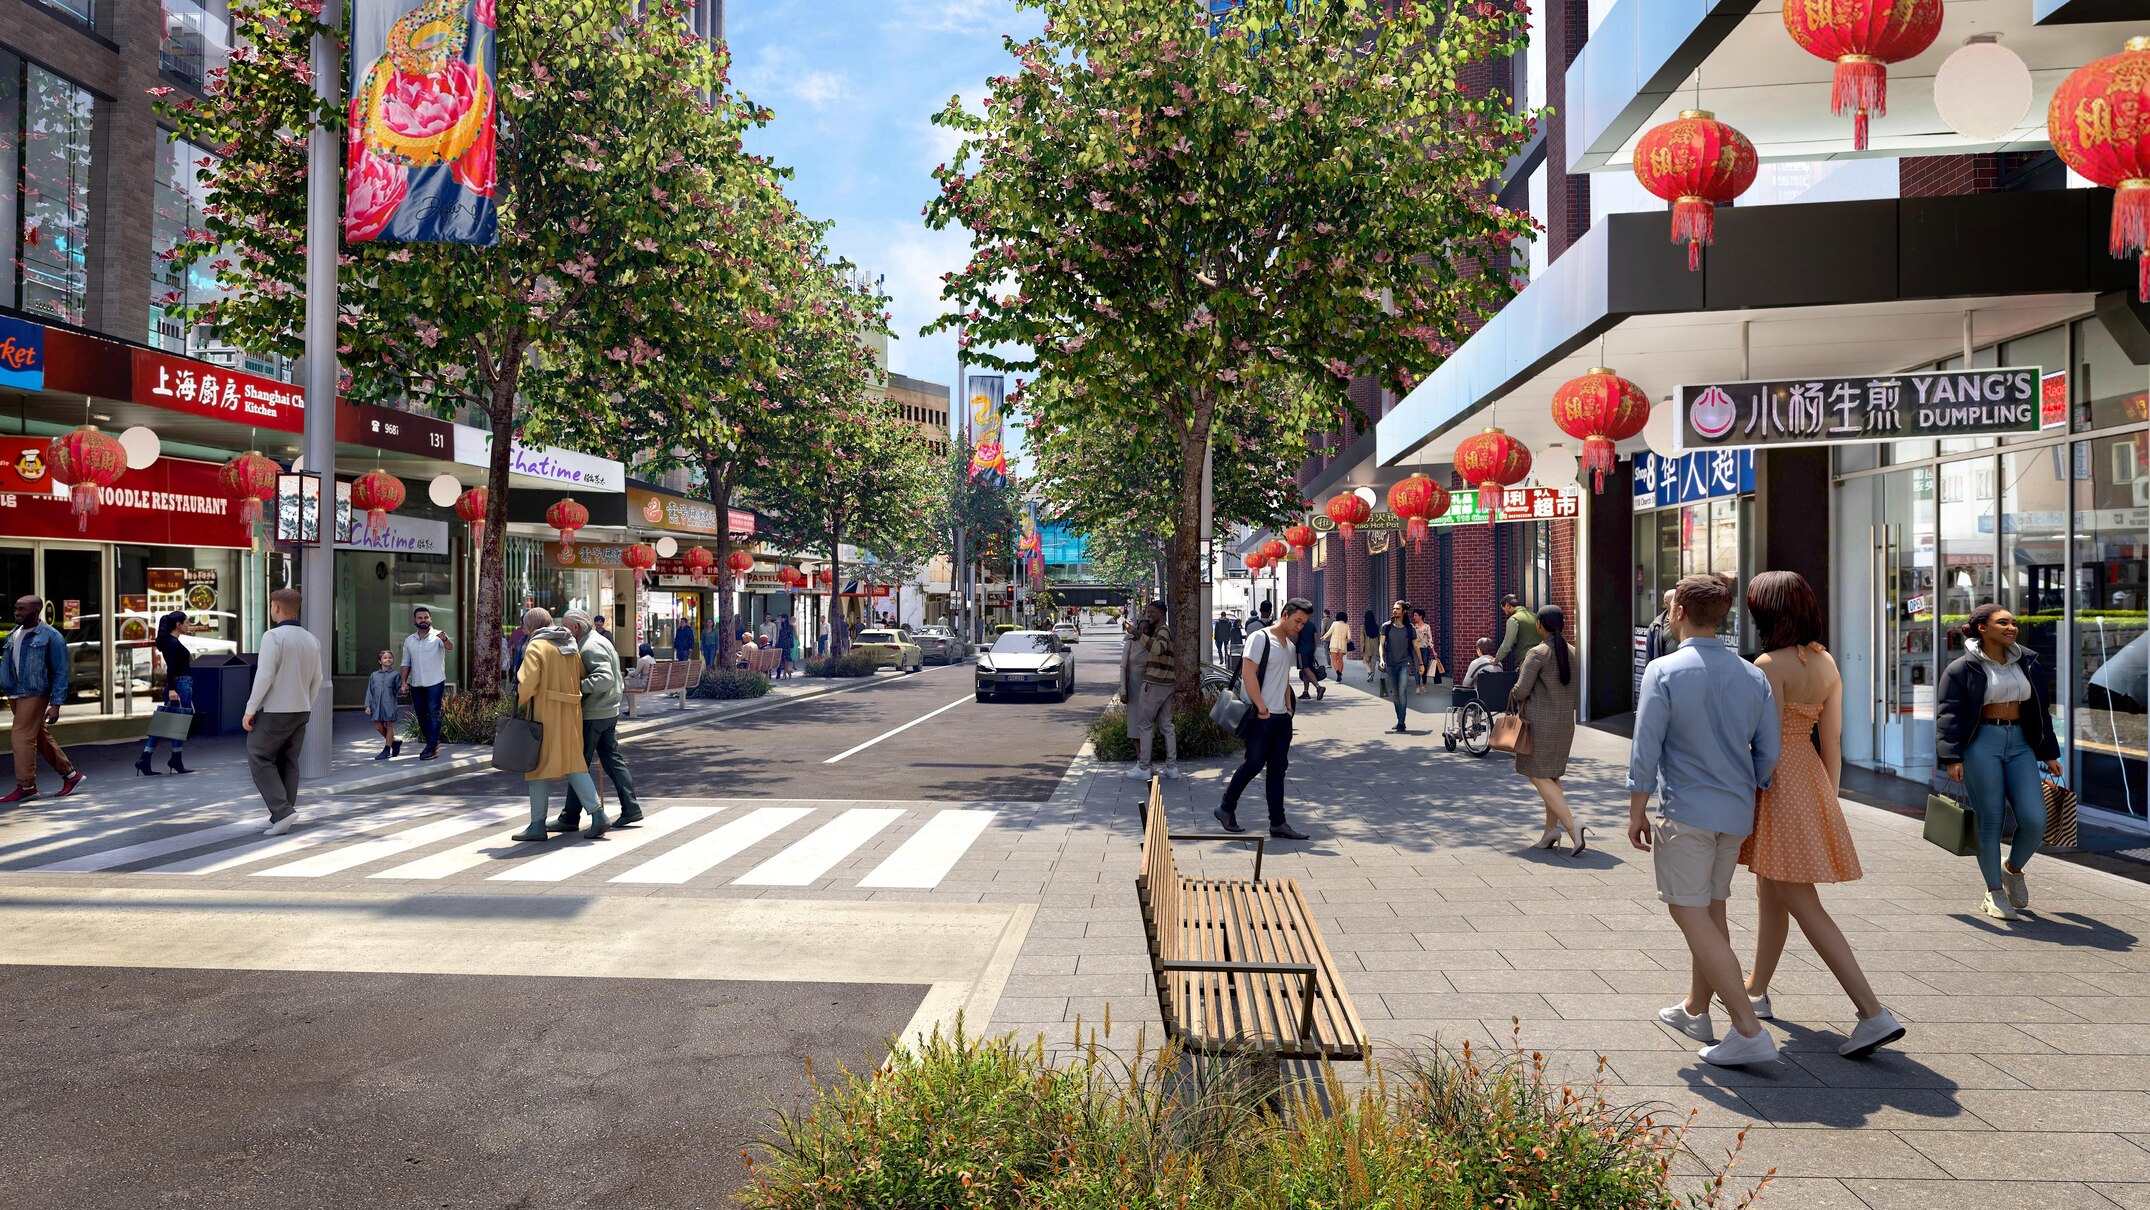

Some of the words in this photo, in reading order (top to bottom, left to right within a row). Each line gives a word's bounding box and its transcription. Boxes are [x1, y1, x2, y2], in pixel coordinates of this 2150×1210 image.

[152, 365, 242, 411] 上海廚房
[244, 384, 290, 407] Shanghai
[291, 395, 305, 409] Ch
[1911, 372, 2033, 404] YANG'S
[244, 401, 277, 418] Kitchen
[1744, 379, 1902, 436] 小杨生煎
[1919, 404, 2033, 428] DUMPLING
[429, 432, 444, 449] 131
[1634, 466, 1648, 483] Shop
[1646, 452, 1656, 492] 8
[1660, 449, 1756, 503] 华人超
[98, 486, 150, 509] NOODLE
[152, 491, 228, 515] RESTAURANT
[1533, 496, 1577, 517] 超市
[1371, 521, 1385, 529] Hot
[1386, 521, 1400, 529] Pot
[1909, 596, 1924, 612] OPEN
